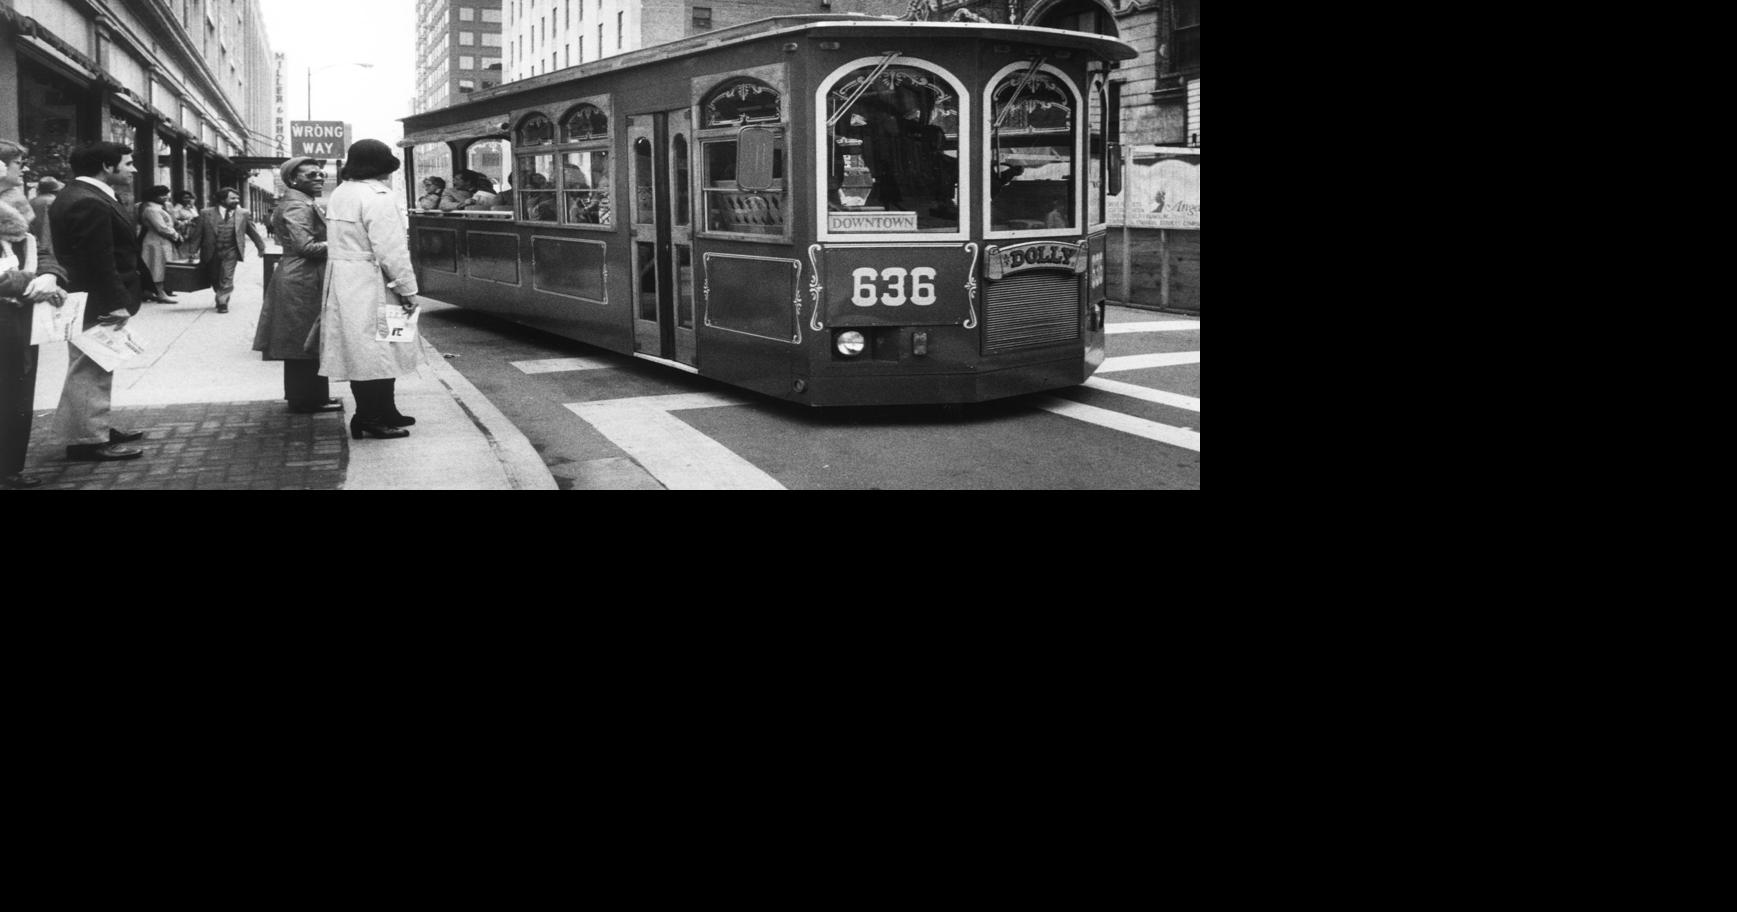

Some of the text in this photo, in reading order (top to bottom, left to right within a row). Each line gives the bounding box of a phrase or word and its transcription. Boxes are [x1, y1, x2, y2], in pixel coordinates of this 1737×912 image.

[275, 52, 284, 102] MILLER
[292, 126, 343, 138] WRONG
[302, 142, 334, 154] WAY
[832, 216, 914, 229] DOWNTOWN
[1010, 246, 1074, 268] DOLLY
[851, 267, 937, 306] 636
